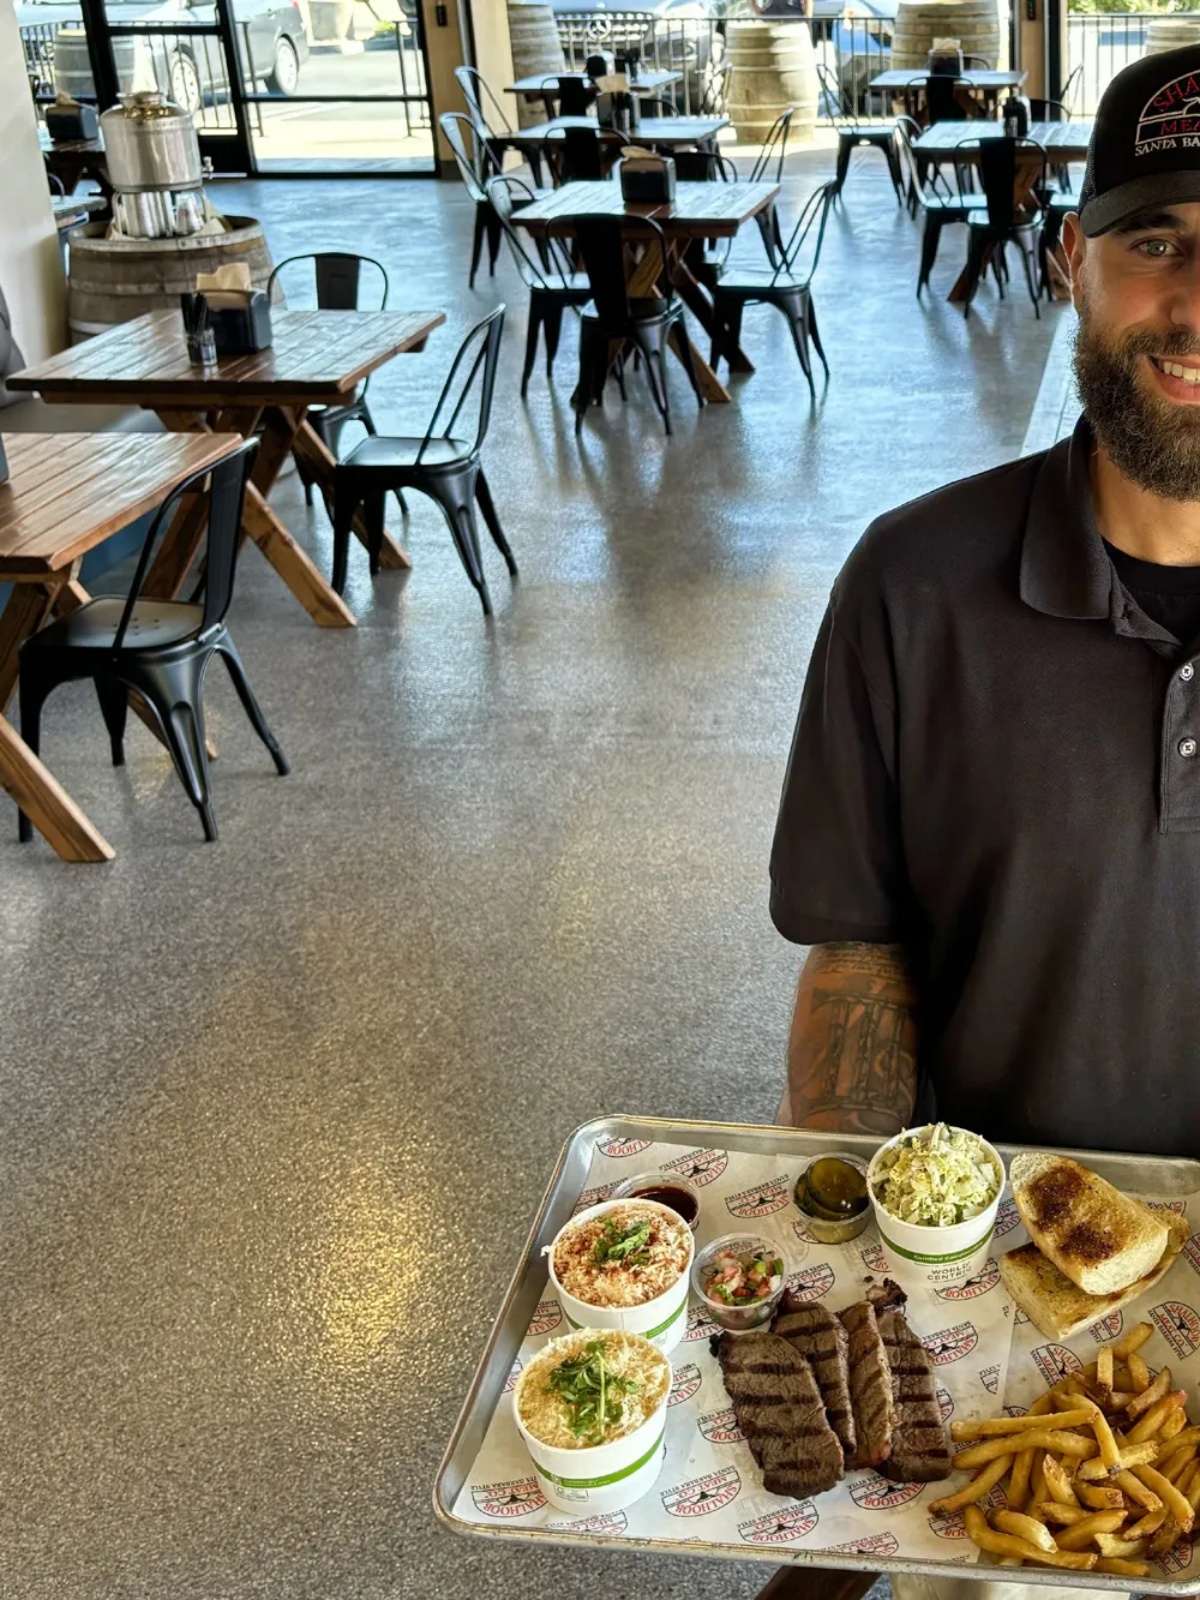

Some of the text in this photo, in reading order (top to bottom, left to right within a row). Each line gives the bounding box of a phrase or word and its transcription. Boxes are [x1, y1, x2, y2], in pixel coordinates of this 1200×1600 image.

[1135, 138, 1177, 156] SANTA
[927, 1265, 971, 1280] CENTRIC
[931, 1261, 970, 1275] WORLD
[935, 1339, 974, 1362] SHALHO
[864, 1482, 921, 1507] HALHOOB
